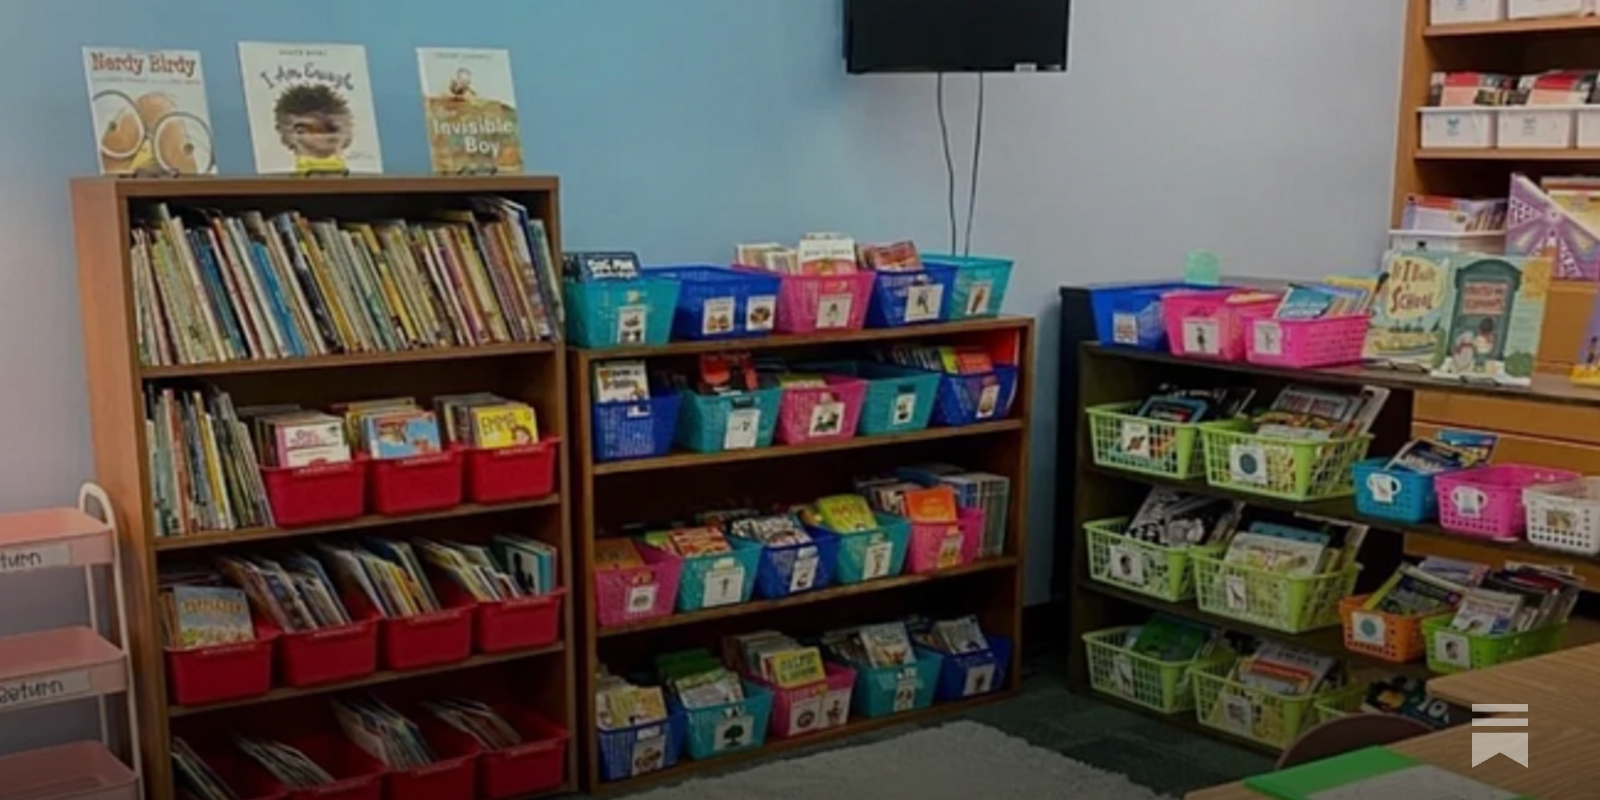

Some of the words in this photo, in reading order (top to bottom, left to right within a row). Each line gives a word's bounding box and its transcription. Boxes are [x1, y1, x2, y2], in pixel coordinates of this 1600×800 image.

[90, 52, 144, 76] Nerdy
[149, 53, 196, 78] Birdy
[433, 116, 514, 135] Invisible
[464, 136, 501, 158] Boy
